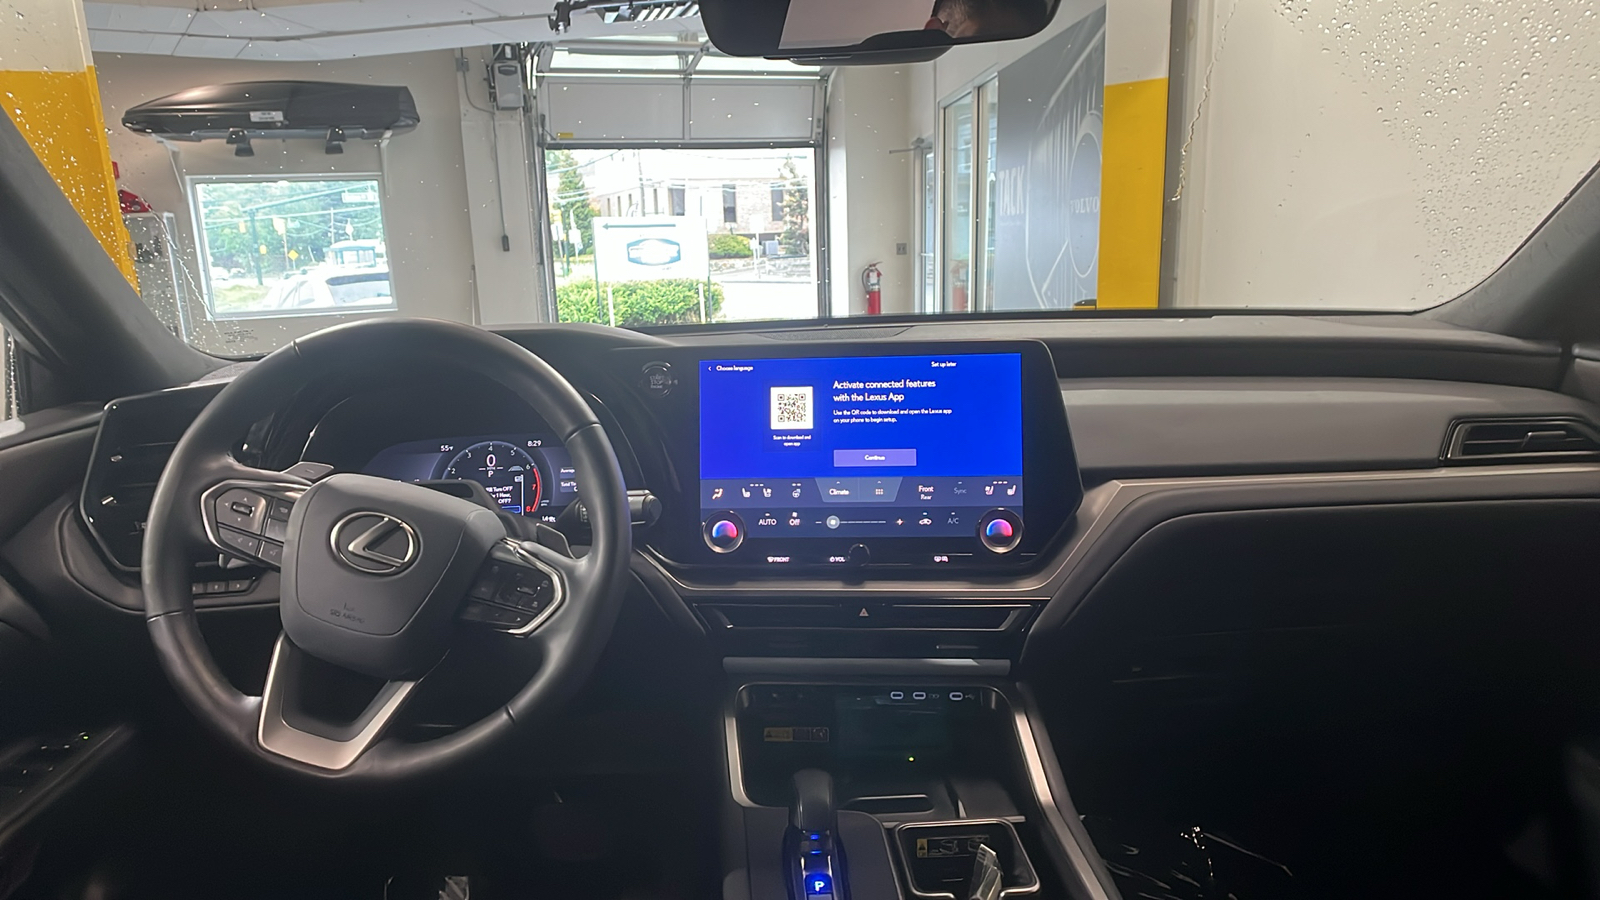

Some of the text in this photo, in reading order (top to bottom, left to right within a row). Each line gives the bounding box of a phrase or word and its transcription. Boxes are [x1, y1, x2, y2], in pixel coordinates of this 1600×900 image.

[833, 379, 936, 389] Activate connected features
[833, 392, 904, 402] with the Lexus App
[486, 454, 496, 467] 0
[954, 487, 967, 495] Sync
[814, 881, 825, 892] P
